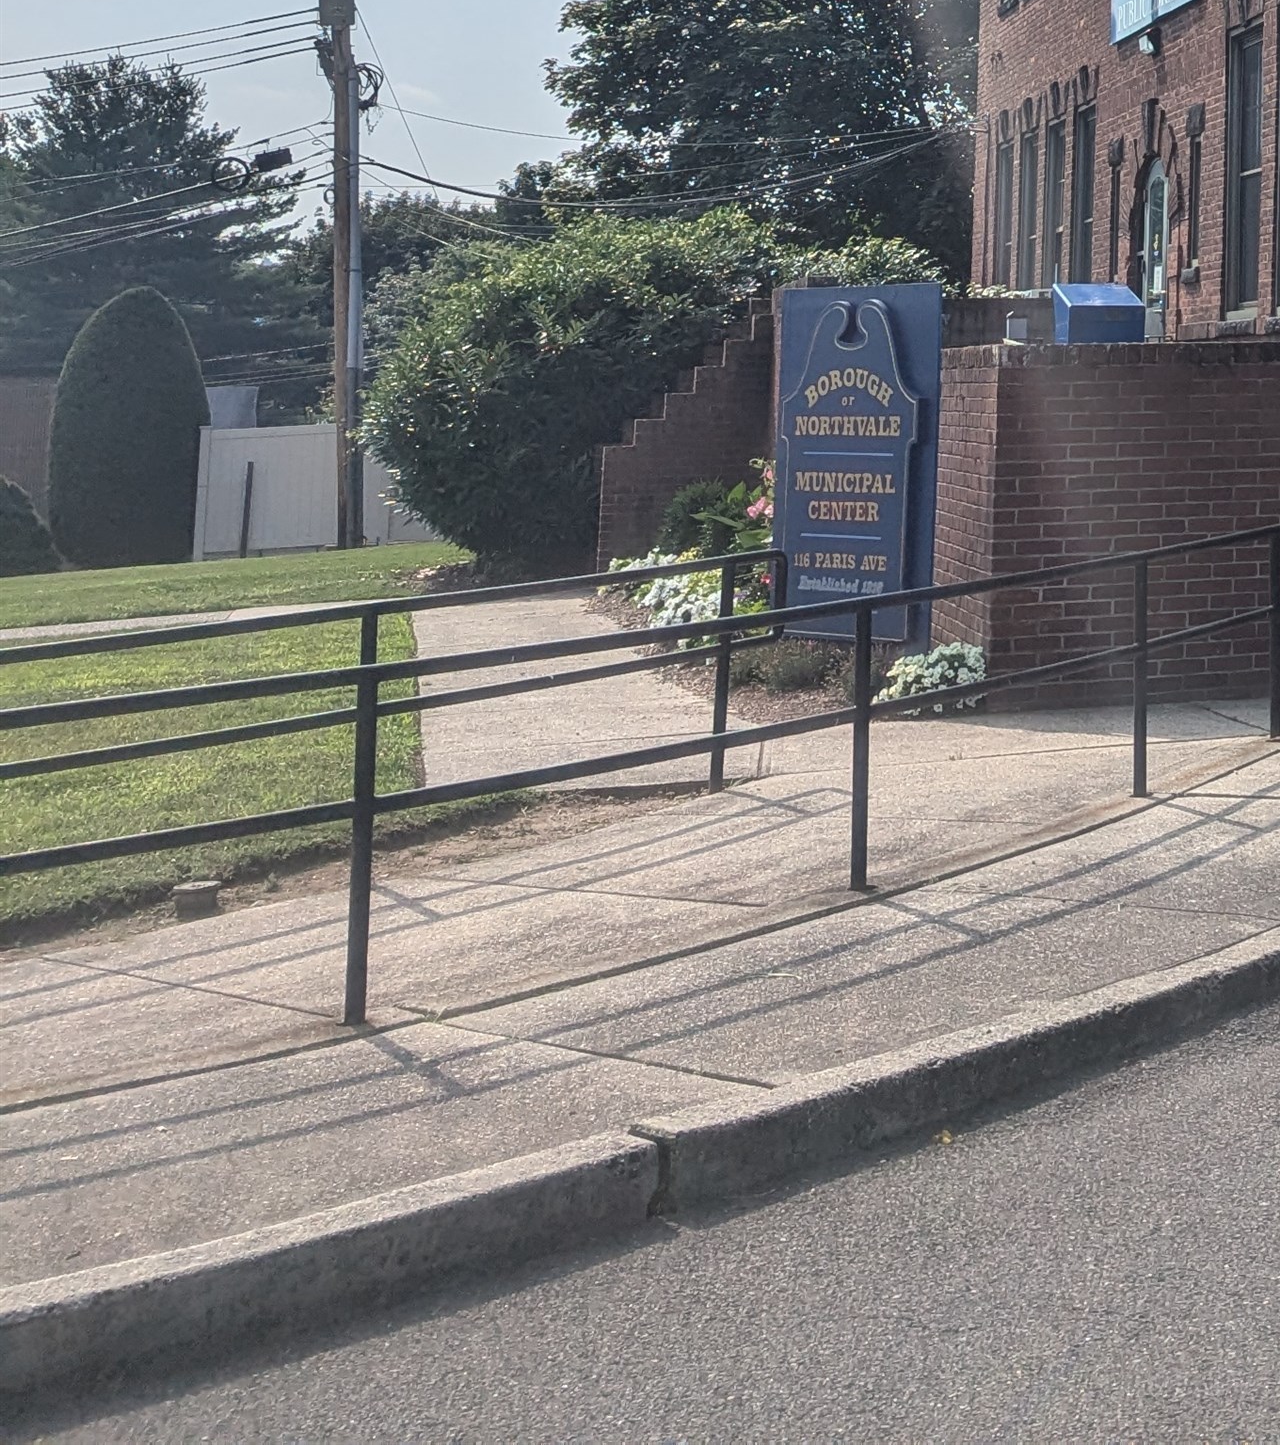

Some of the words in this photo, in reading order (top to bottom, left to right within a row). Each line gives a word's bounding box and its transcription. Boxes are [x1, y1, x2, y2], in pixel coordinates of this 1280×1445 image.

[804, 367, 894, 409] BOROUGH
[795, 415, 901, 437] NORTHVALE
[795, 471, 896, 494] MUNICIPAL
[808, 500, 880, 522] CENTER
[794, 552, 811, 568] 116
[814, 552, 857, 570] PARIS
[860, 555, 888, 572] AVE
